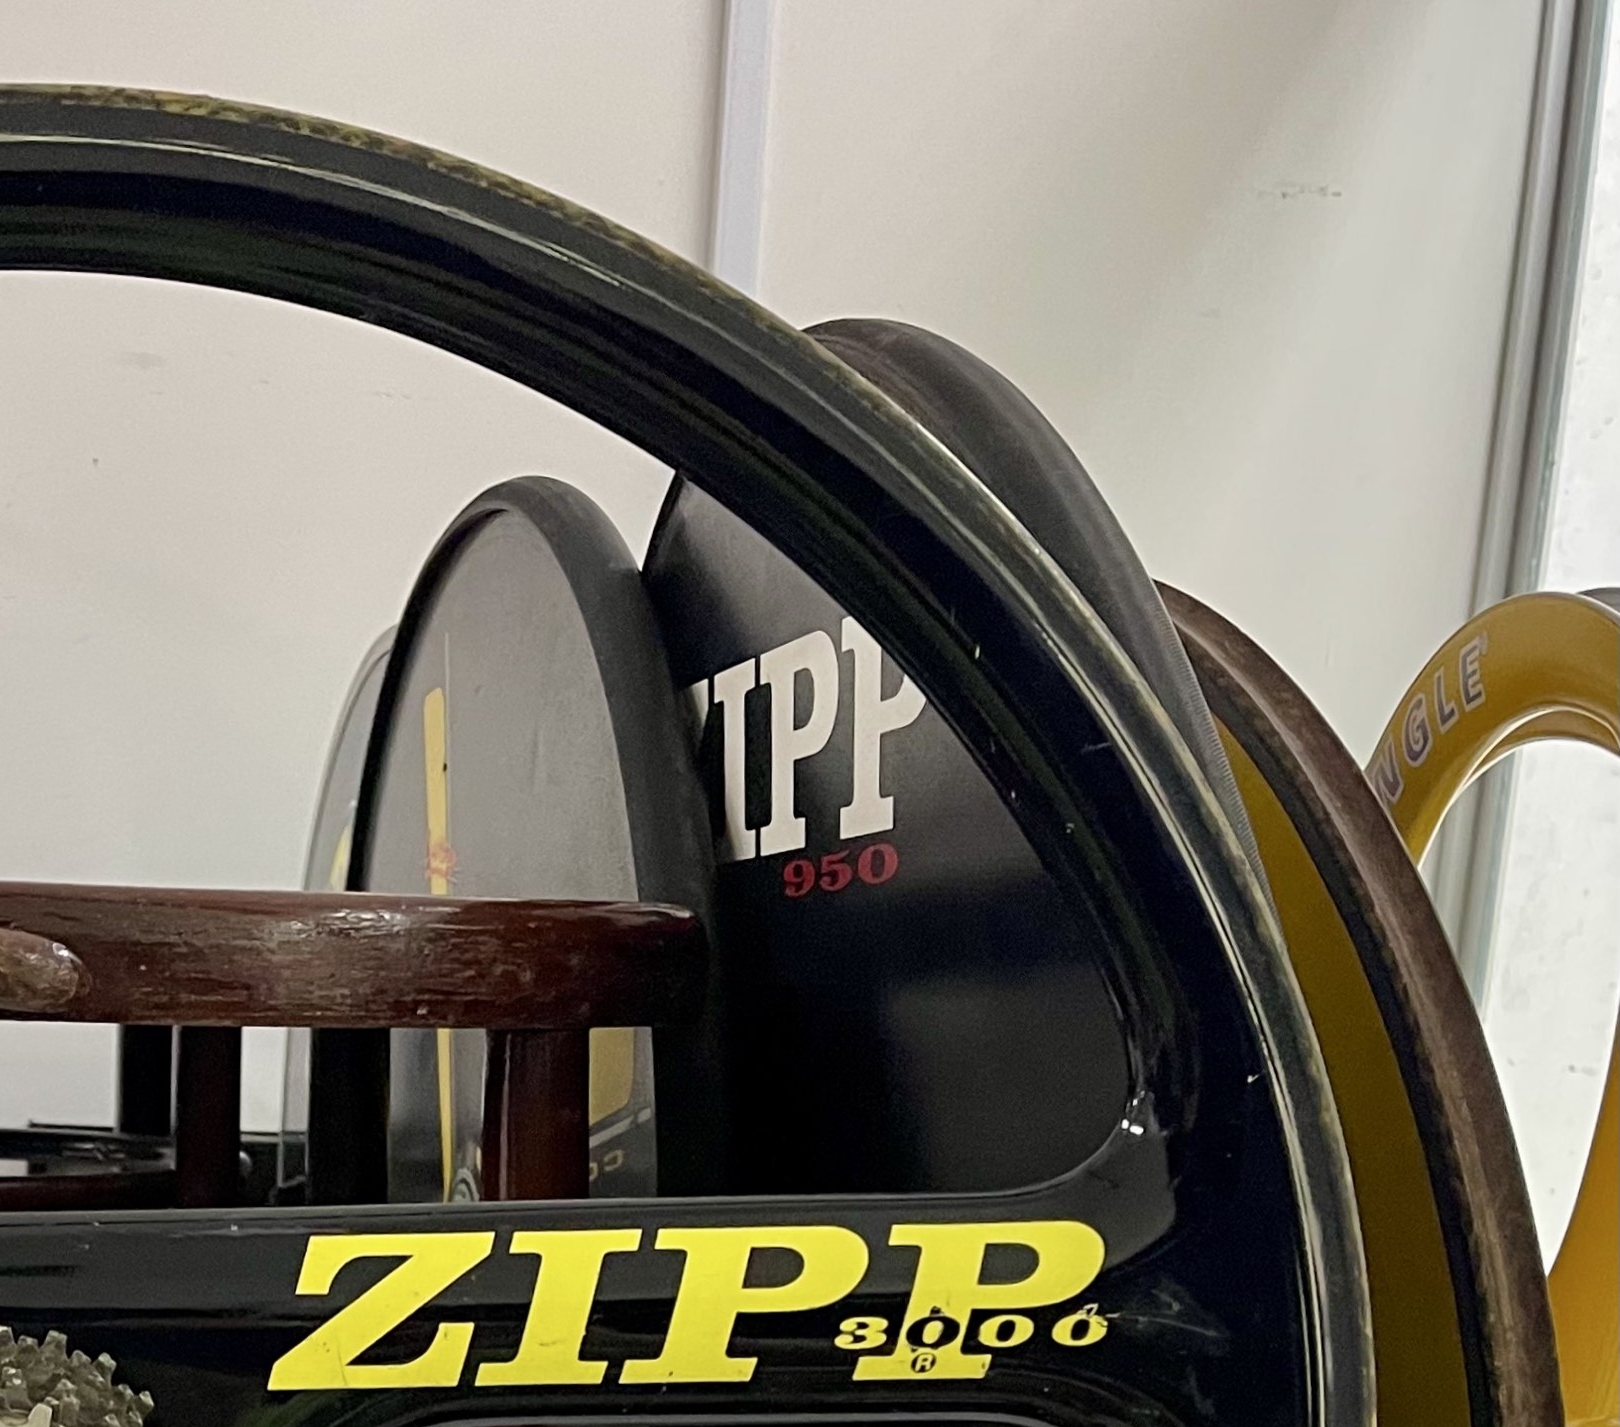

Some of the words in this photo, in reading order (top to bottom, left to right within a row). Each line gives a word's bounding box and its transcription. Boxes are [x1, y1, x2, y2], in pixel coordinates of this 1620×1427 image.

[782, 842, 900, 899] 950
[266, 1219, 1107, 1391] ZIPP
[833, 1308, 1109, 1351] 3000
